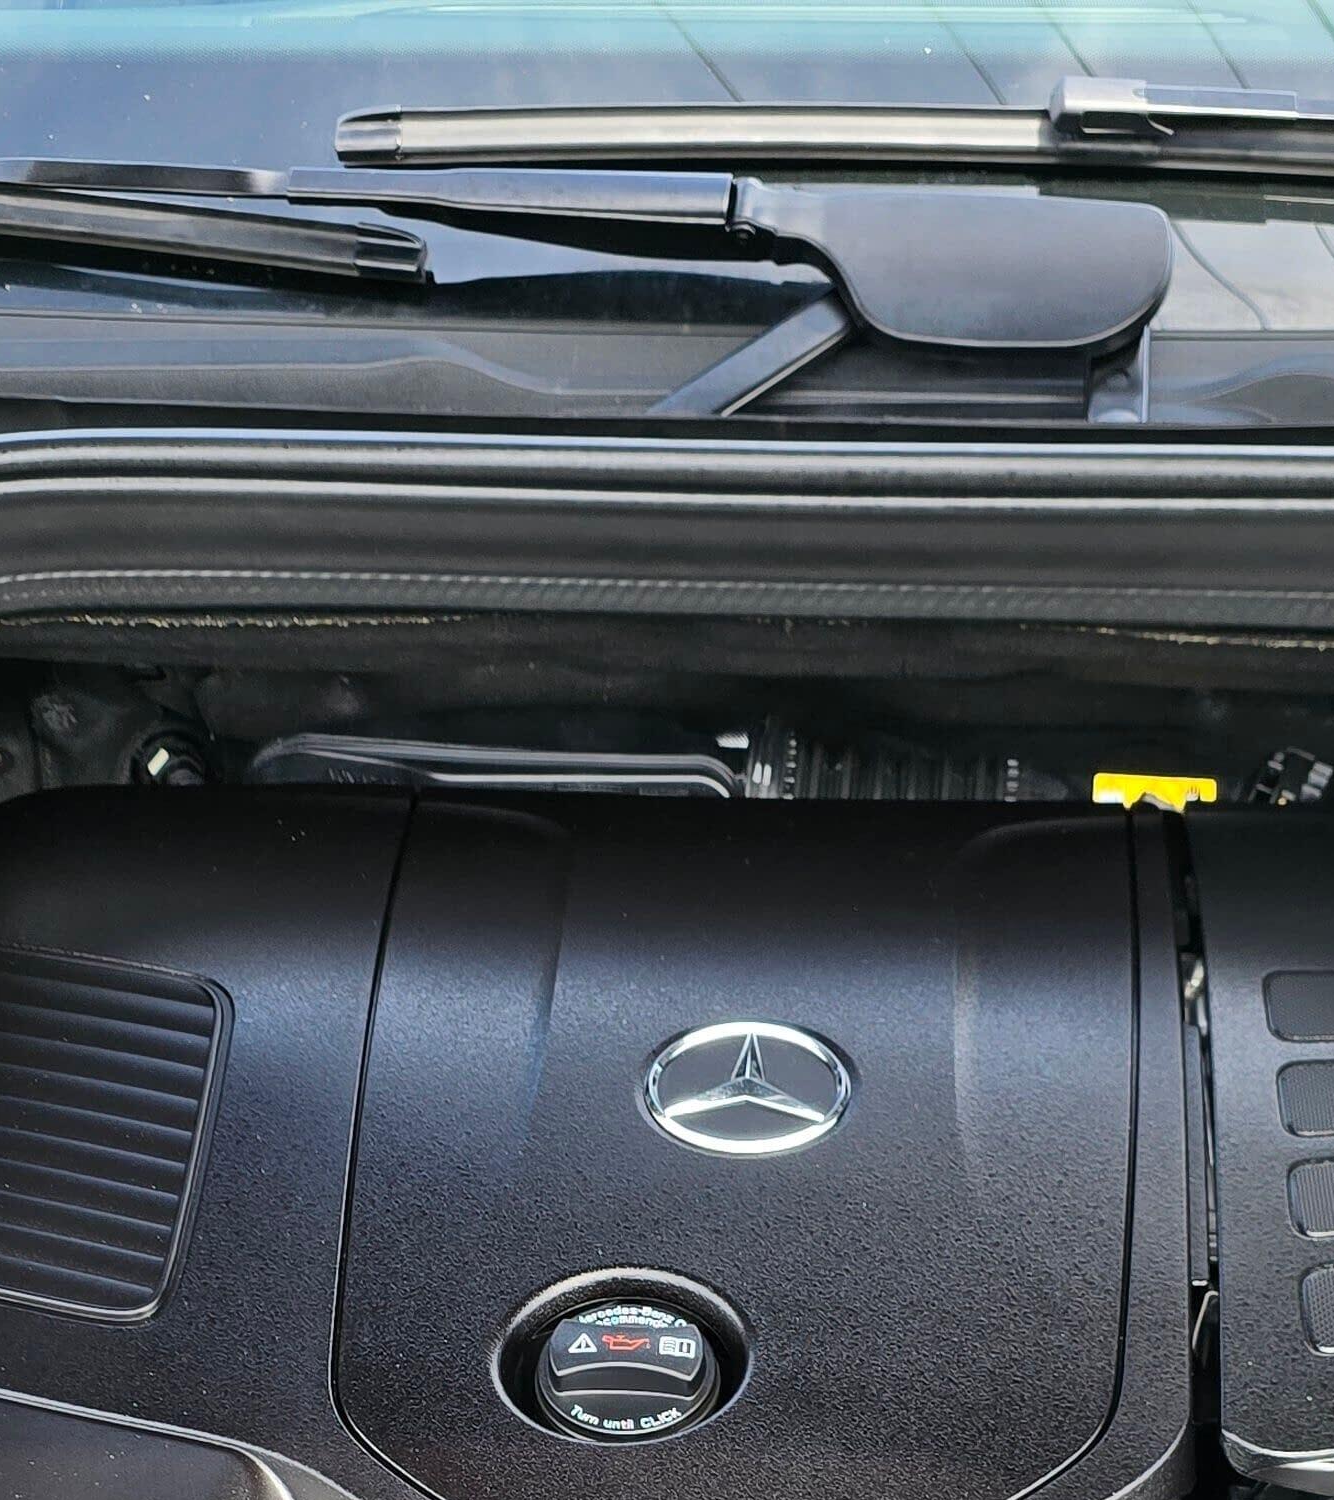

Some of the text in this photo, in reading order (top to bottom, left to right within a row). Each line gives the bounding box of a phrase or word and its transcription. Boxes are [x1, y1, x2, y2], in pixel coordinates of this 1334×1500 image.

[578, 1306, 675, 1324] ercedes-Benz
[570, 1404, 682, 1430] Turn until CLICK
